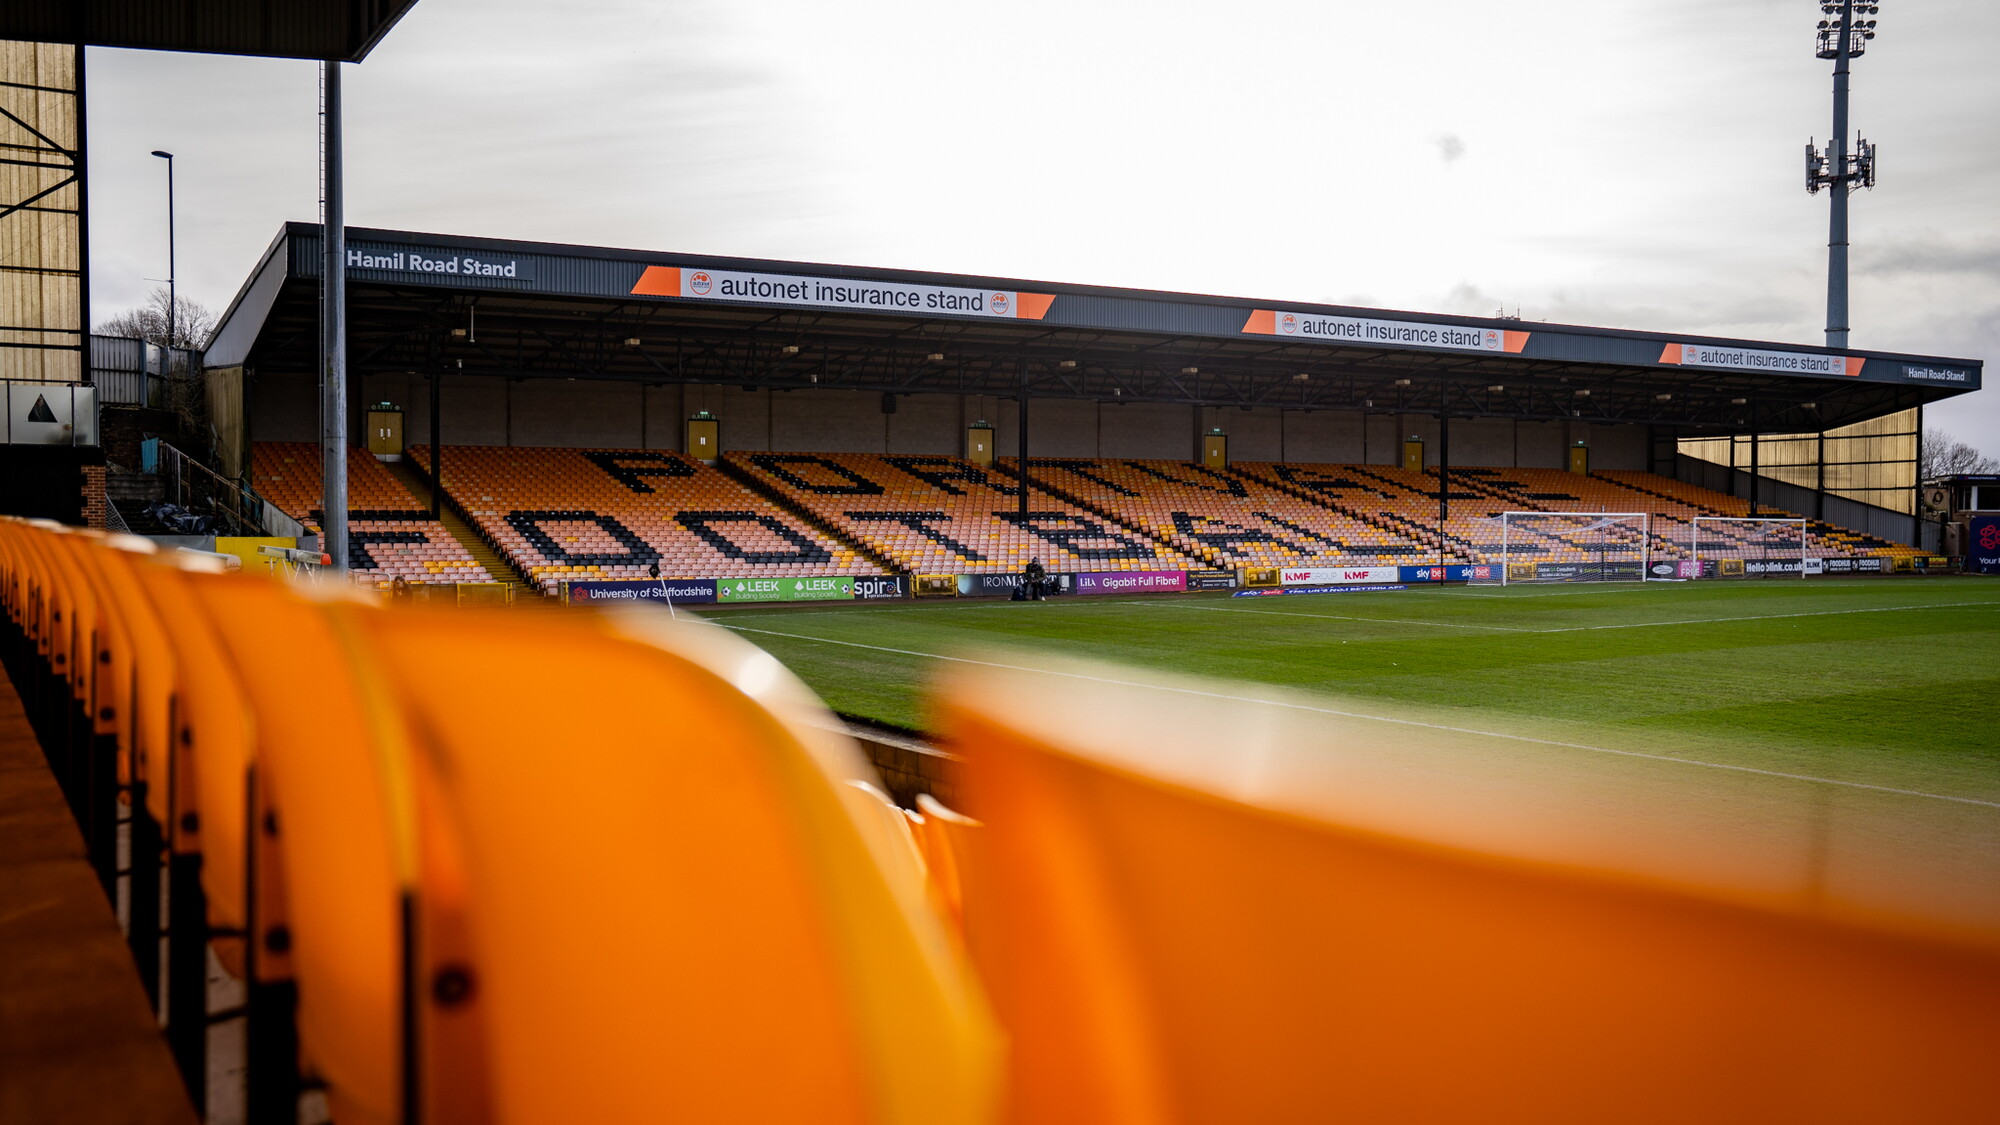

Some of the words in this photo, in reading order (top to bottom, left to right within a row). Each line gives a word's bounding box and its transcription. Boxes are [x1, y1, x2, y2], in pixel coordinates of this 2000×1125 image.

[347, 250, 404, 270] Hamil
[409, 254, 458, 274] Road
[463, 258, 516, 277] Stand
[721, 277, 809, 300] autonet
[815, 282, 920, 307] insurance
[926, 290, 983, 312] stand
[1303, 319, 1361, 338] autonet
[1366, 322, 1438, 343] insurance
[1441, 329, 1481, 347] stand
[1701, 349, 1743, 366] autonet
[1746, 351, 1798, 369] insurance
[1801, 356, 1829, 371] stand
[1908, 367, 1928, 379] Hamil
[1928, 368, 1946, 380] Road
[1946, 370, 1965, 381] Stand
[1746, 562, 1765, 572] Hello
[1979, 557, 1998, 565] Your
[1285, 572, 1311, 581] KMF
[1311, 572, 1337, 580] GROUP
[1344, 571, 1369, 580] KMF
[1369, 571, 1394, 579] GROUP
[1416, 568, 1430, 580] sky
[1461, 567, 1475, 578] sky
[1475, 567, 1489, 577] bet
[747, 581, 780, 592] LEEK
[806, 579, 837, 591] LEEK
[1102, 576, 1136, 590] Gigabit
[1138, 576, 1154, 587] Full
[1155, 575, 1180, 586] Fibre!
[590, 588, 638, 599] University
[640, 587, 651, 598] of
[652, 586, 713, 597] Staffordshire
